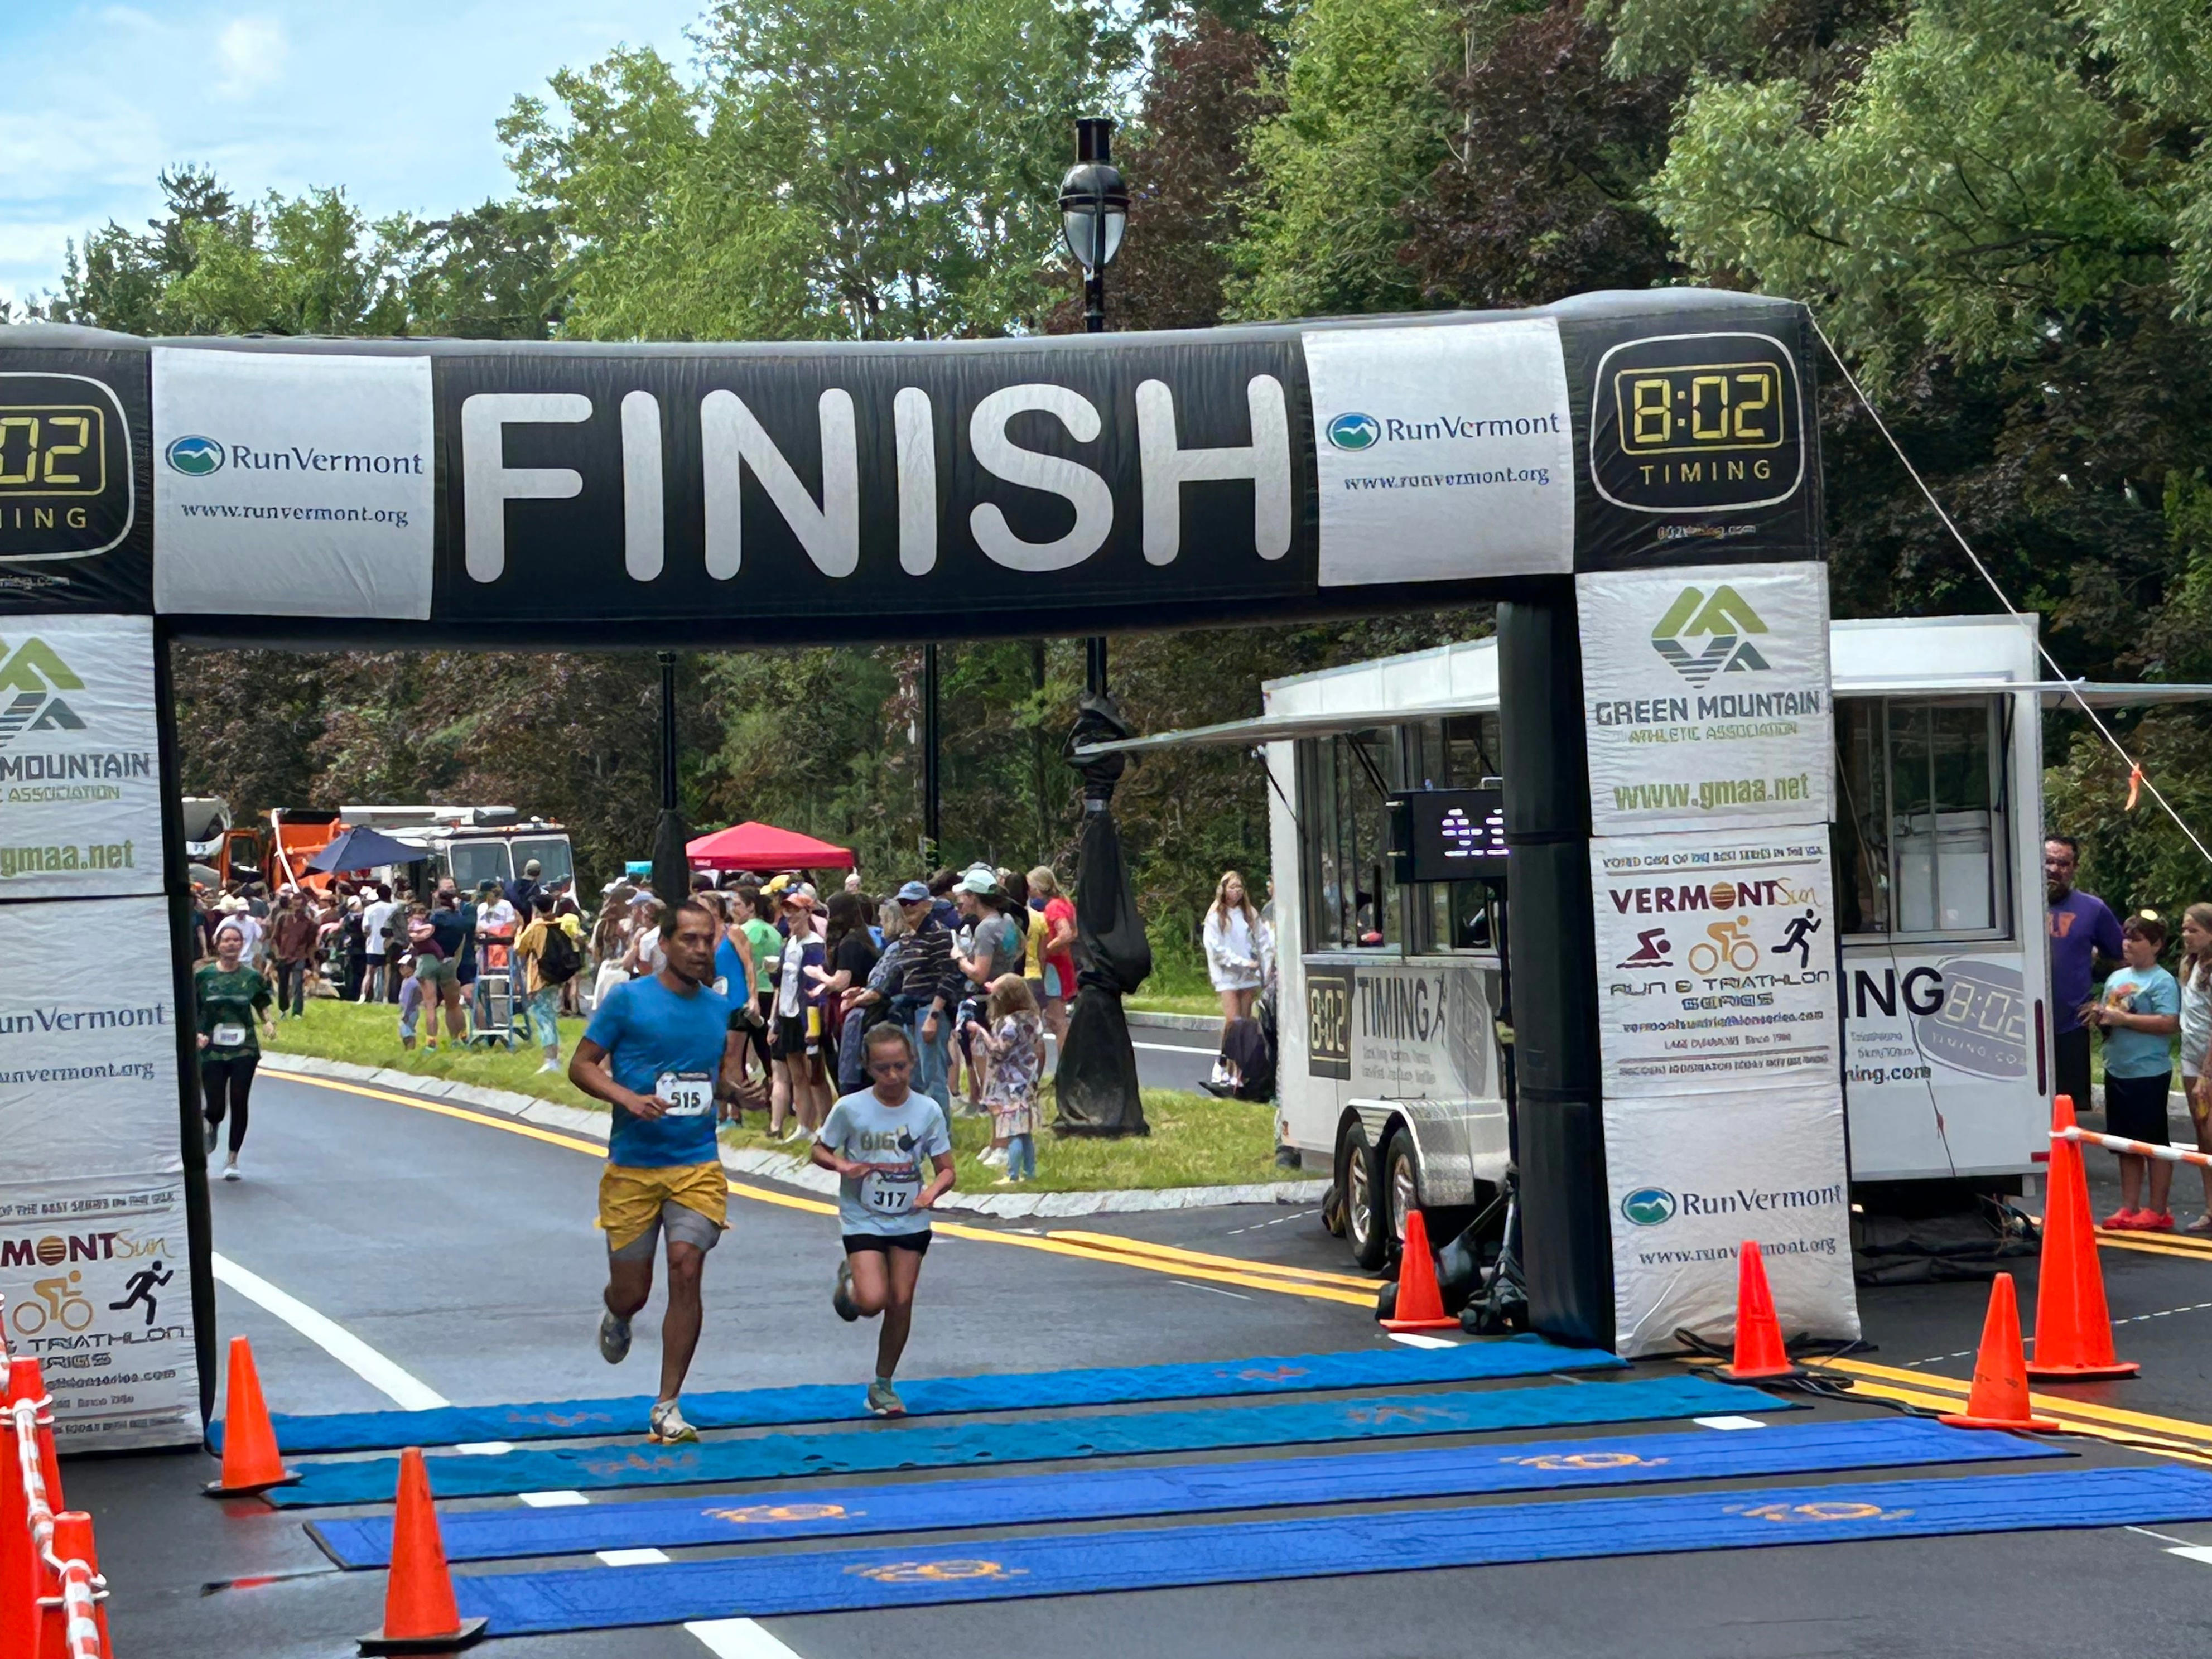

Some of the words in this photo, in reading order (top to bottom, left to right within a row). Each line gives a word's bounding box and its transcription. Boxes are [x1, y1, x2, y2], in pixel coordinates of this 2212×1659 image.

[1633, 374, 1770, 444] 8:02
[1387, 411, 1560, 443] RunVermont
[232, 445, 424, 475] RunVermont
[1640, 459, 1771, 485] TIMING
[461, 374, 1291, 583] FINISH
[1344, 466, 1550, 491] www.runvermont.org
[0, 507, 86, 529] ING
[181, 502, 408, 529] www.runvermont.org
[1596, 697, 1688, 725] GREEN
[1697, 691, 1821, 720] MOUNTAIN
[1628, 727, 1701, 744] ATHLETIC
[1707, 721, 1797, 740] ASSOCIATION
[0, 753, 150, 781] MOUNTAIN
[9, 785, 120, 802] ASSOCIATION
[1613, 773, 1810, 811] www.gmaa.net
[1702, 971, 1829, 992] TRIATHLON
[1357, 977, 1429, 1043] TIMING
[874, 1190, 907, 1207] 317
[1682, 1184, 1843, 1216] RunVermont
[1640, 1237, 1837, 1265] www.runvmont.org
[28, 1327, 185, 1352] TRIATHLON
